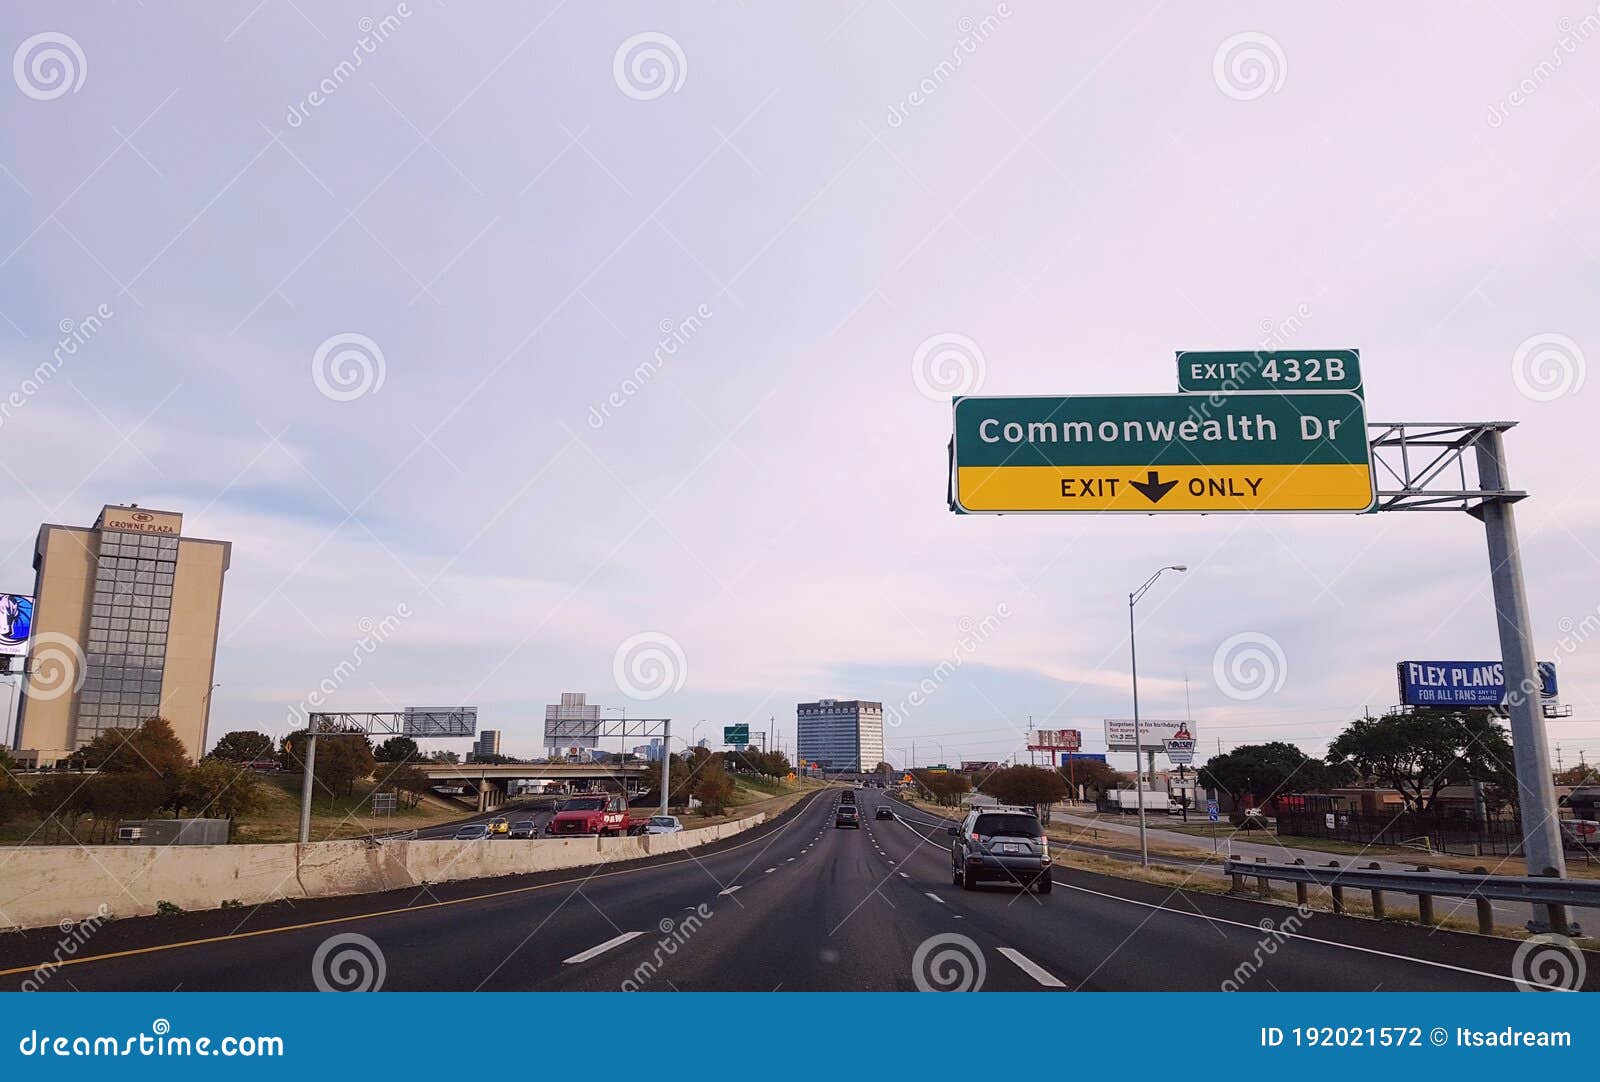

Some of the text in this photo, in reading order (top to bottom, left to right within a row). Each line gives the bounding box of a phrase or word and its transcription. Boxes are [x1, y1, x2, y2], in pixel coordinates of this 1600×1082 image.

[1191, 358, 1346, 382] EXIT 432B
[978, 413, 1341, 443] Commonwealth Dr
[1061, 477, 1264, 497] EXIT ONLY
[109, 520, 174, 533] CROWNE PLAZA
[1409, 663, 1504, 687] FLEX PLANS
[1418, 689, 1476, 701] FOR ALL FANS
